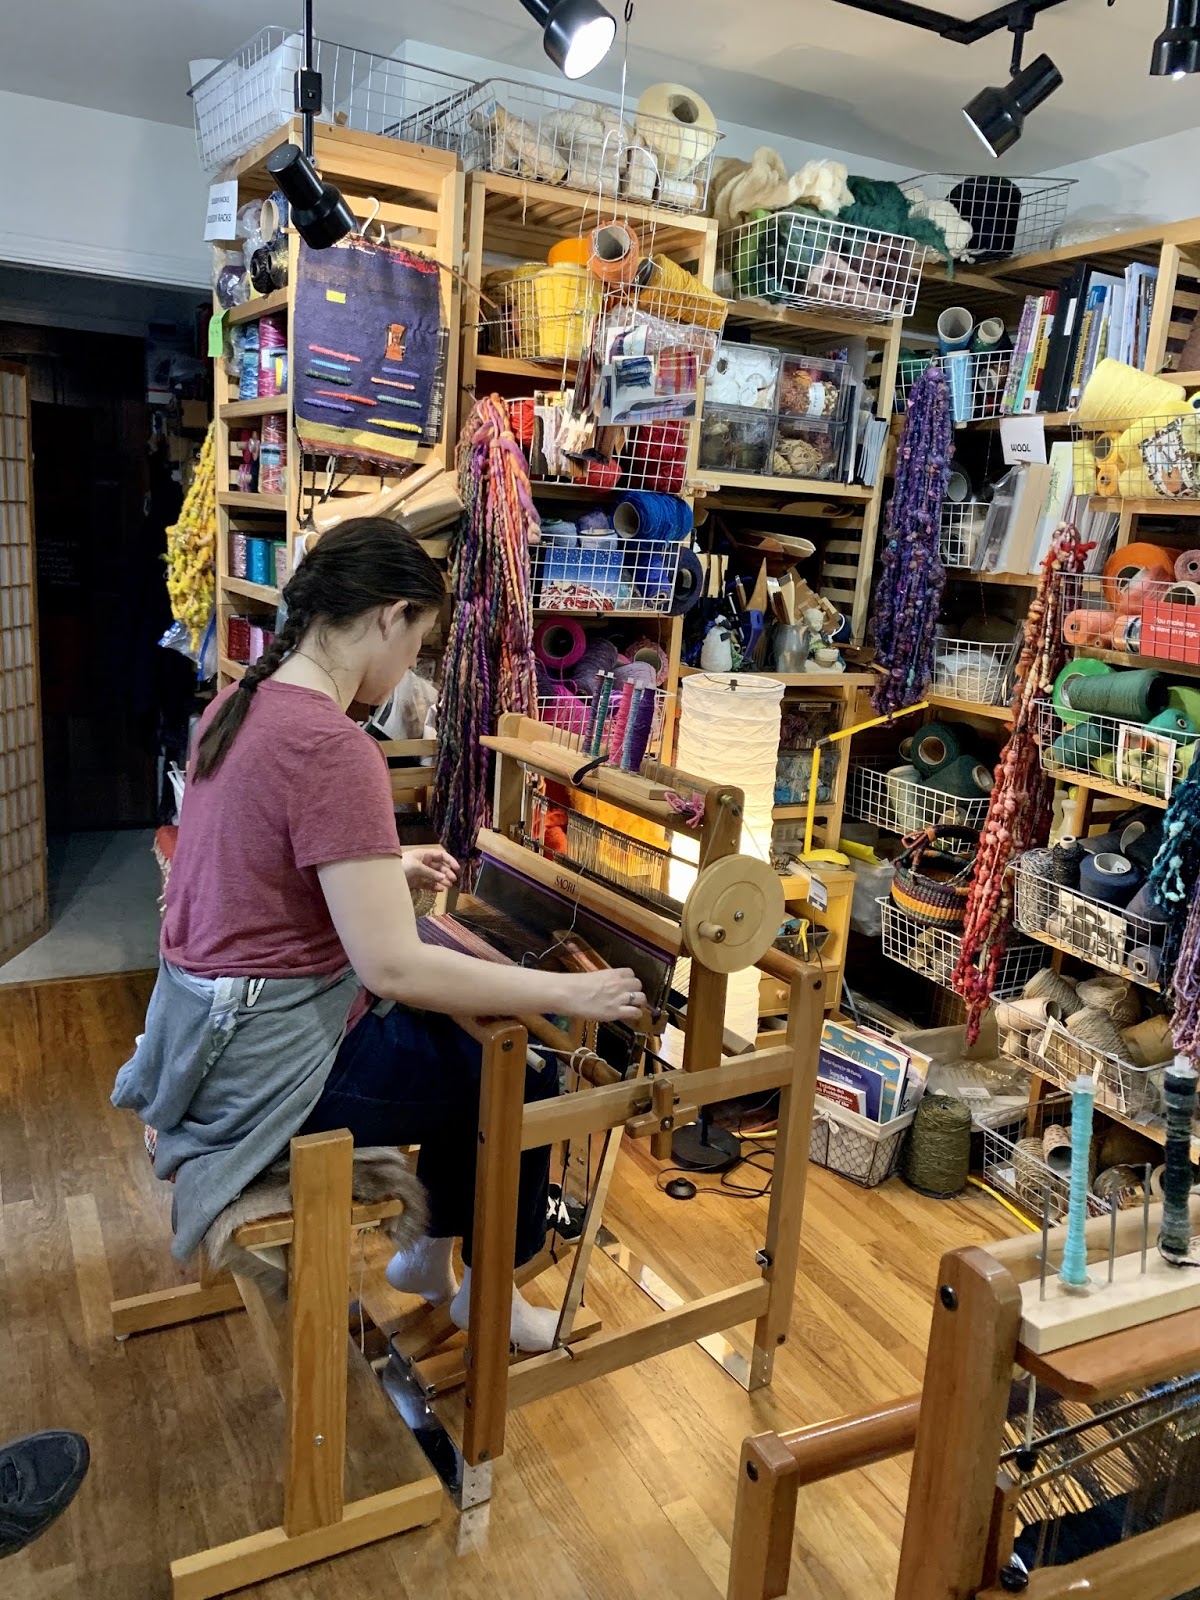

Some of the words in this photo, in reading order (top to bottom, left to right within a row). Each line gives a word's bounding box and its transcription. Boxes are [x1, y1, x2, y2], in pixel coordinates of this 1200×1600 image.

[1011, 443, 1032, 452] WOOL
[1154, 615, 1166, 625] You
[555, 875, 576, 895] SAORI
